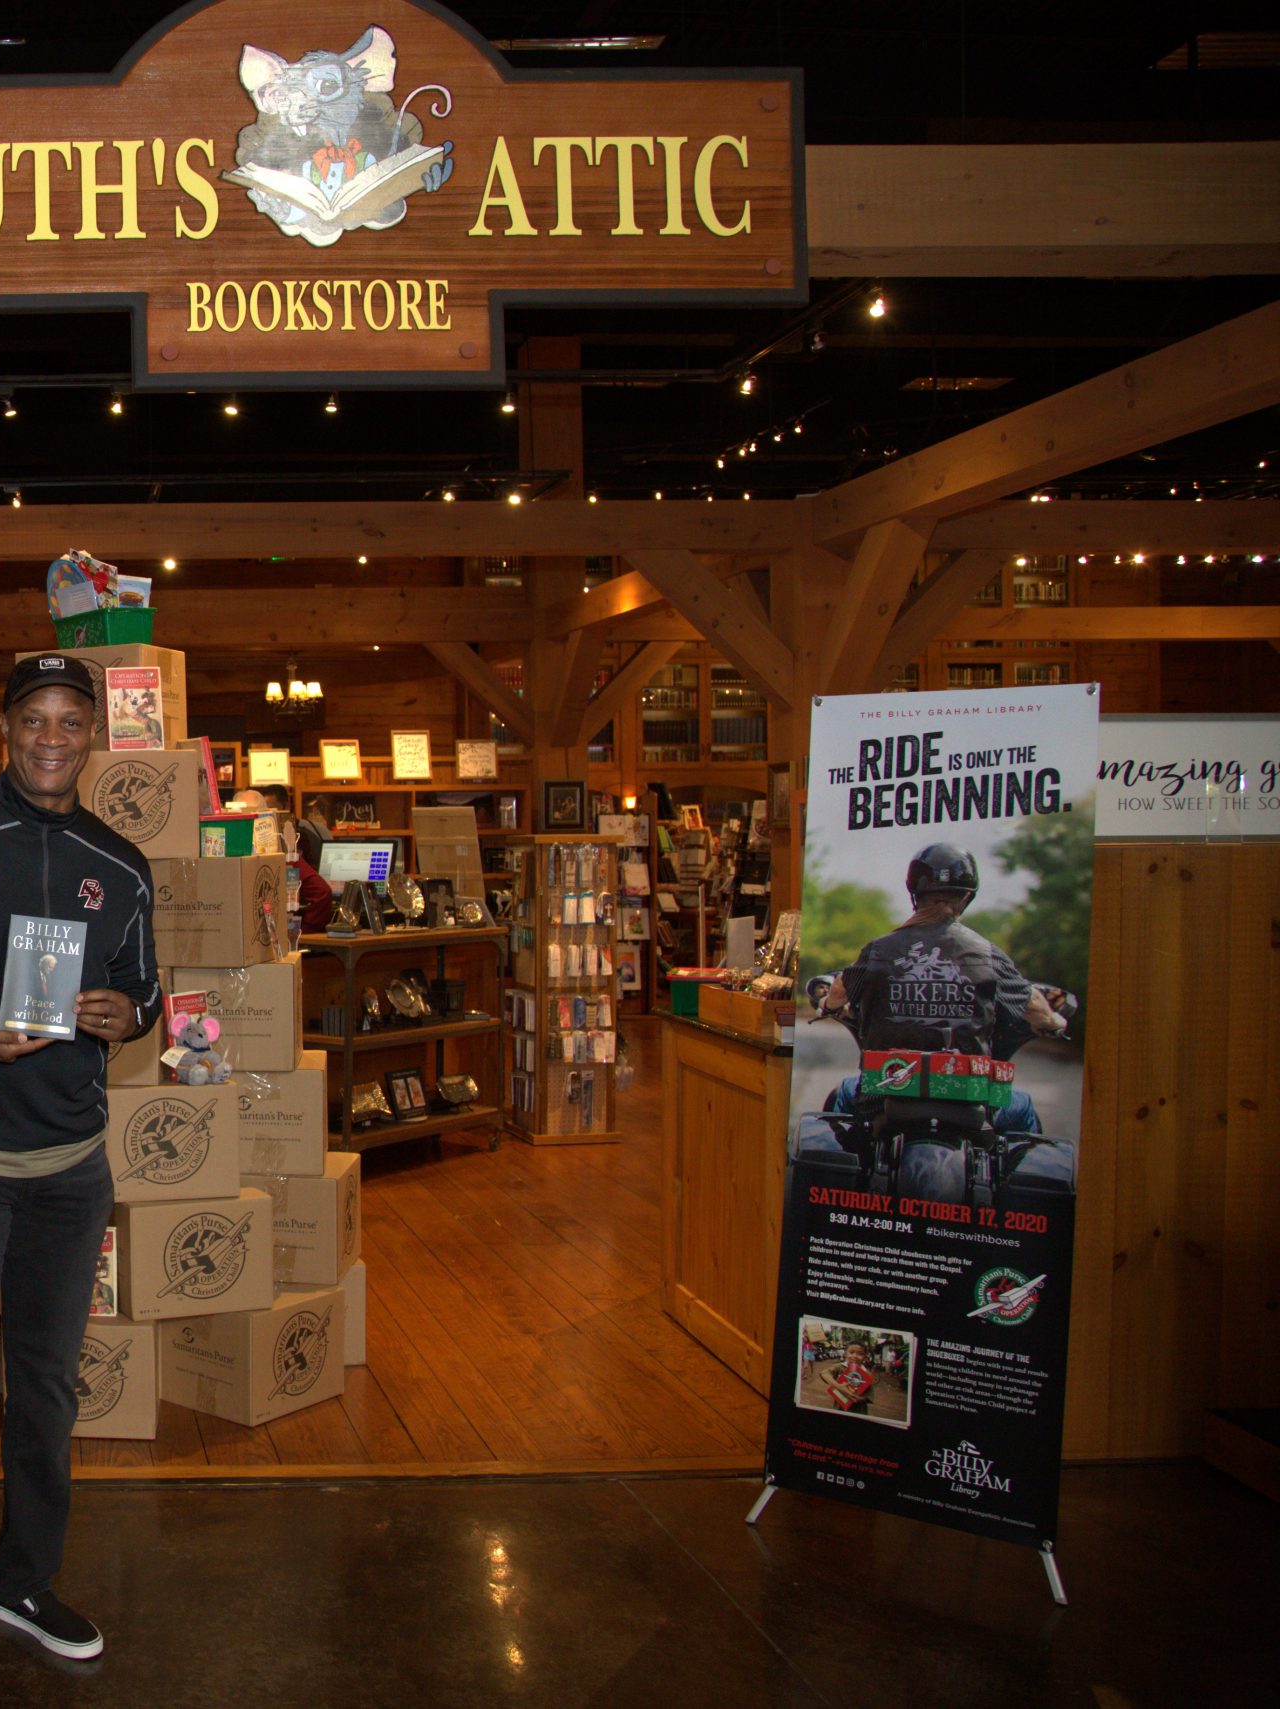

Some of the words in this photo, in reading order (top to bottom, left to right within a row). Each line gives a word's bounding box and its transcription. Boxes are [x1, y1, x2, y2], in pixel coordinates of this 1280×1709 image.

[467, 134, 751, 239] ATTIC
[185, 278, 453, 334] BOOKSTORE
[860, 711, 882, 719] THE
[888, 709, 921, 718] BILLY
[928, 707, 980, 716] GRAHAM
[987, 704, 1043, 714] LIBRARY
[828, 767, 854, 785] THE
[858, 731, 944, 782] RIDE
[948, 754, 962, 771] IS
[966, 749, 1003, 770] ONLY
[1007, 745, 1037, 765] THE
[128, 763, 155, 782] Purse
[1096, 758, 1248, 796] mazing
[848, 767, 1072, 831] BEGINNING.
[1118, 797, 1155, 811] HOW
[1162, 797, 1214, 810] SWEET
[1222, 797, 1250, 810] THE
[128, 797, 166, 829] OPERATION
[153, 902, 196, 912] amaritan's
[197, 901, 222, 912] Purse
[25, 921, 72, 939] BILLY
[13, 935, 80, 955] GRAHAM
[25, 995, 55, 1009] Peace
[889, 982, 976, 1002] BIKERS
[14, 1009, 38, 1021] with
[41, 1011, 63, 1024] God
[247, 1006, 273, 1017] Purse
[889, 1002, 925, 1016] WITH
[929, 1003, 975, 1017] BOXES
[277, 1111, 303, 1121] Purse
[131, 1105, 161, 1162] Samaritan's
[162, 1101, 191, 1119] Purse
[163, 1135, 204, 1168] OPERATION
[153, 1169, 191, 1181] Christmas
[189, 1149, 203, 1169] Child
[808, 1186, 893, 1214] SATURDAY,
[899, 1198, 971, 1224] OCTOBER
[977, 1208, 999, 1228] 17,
[1003, 1210, 1048, 1233] 2020
[291, 1218, 317, 1230] Purse
[829, 1213, 848, 1225] 9:30
[894, 1221, 914, 1233] P.M.
[170, 1221, 199, 1277] Samaritan's
[200, 1216, 228, 1233] Purse
[825, 1239, 853, 1249] Operation
[854, 1242, 883, 1253] Christmas
[885, 1246, 900, 1255] Child
[925, 1226, 1021, 1248] #bikerswithboxes
[200, 1249, 240, 1283] OPERATION
[191, 1282, 228, 1296] Christmas
[226, 1261, 240, 1282] Child
[1004, 1268, 1027, 1285] Purse
[82, 1343, 104, 1357] urse
[926, 1338, 939, 1348] THE
[940, 1341, 971, 1353] AMAZING
[973, 1346, 1004, 1359] JOURNEY
[1005, 1351, 1015, 1361] OF
[1017, 1354, 1030, 1364] THE
[926, 1348, 965, 1362] SHOEBOXES
[932, 1450, 942, 1458] The
[942, 1448, 994, 1480] BILLY
[925, 1460, 1011, 1493] GRAHAM
[950, 1482, 980, 1499] Library
